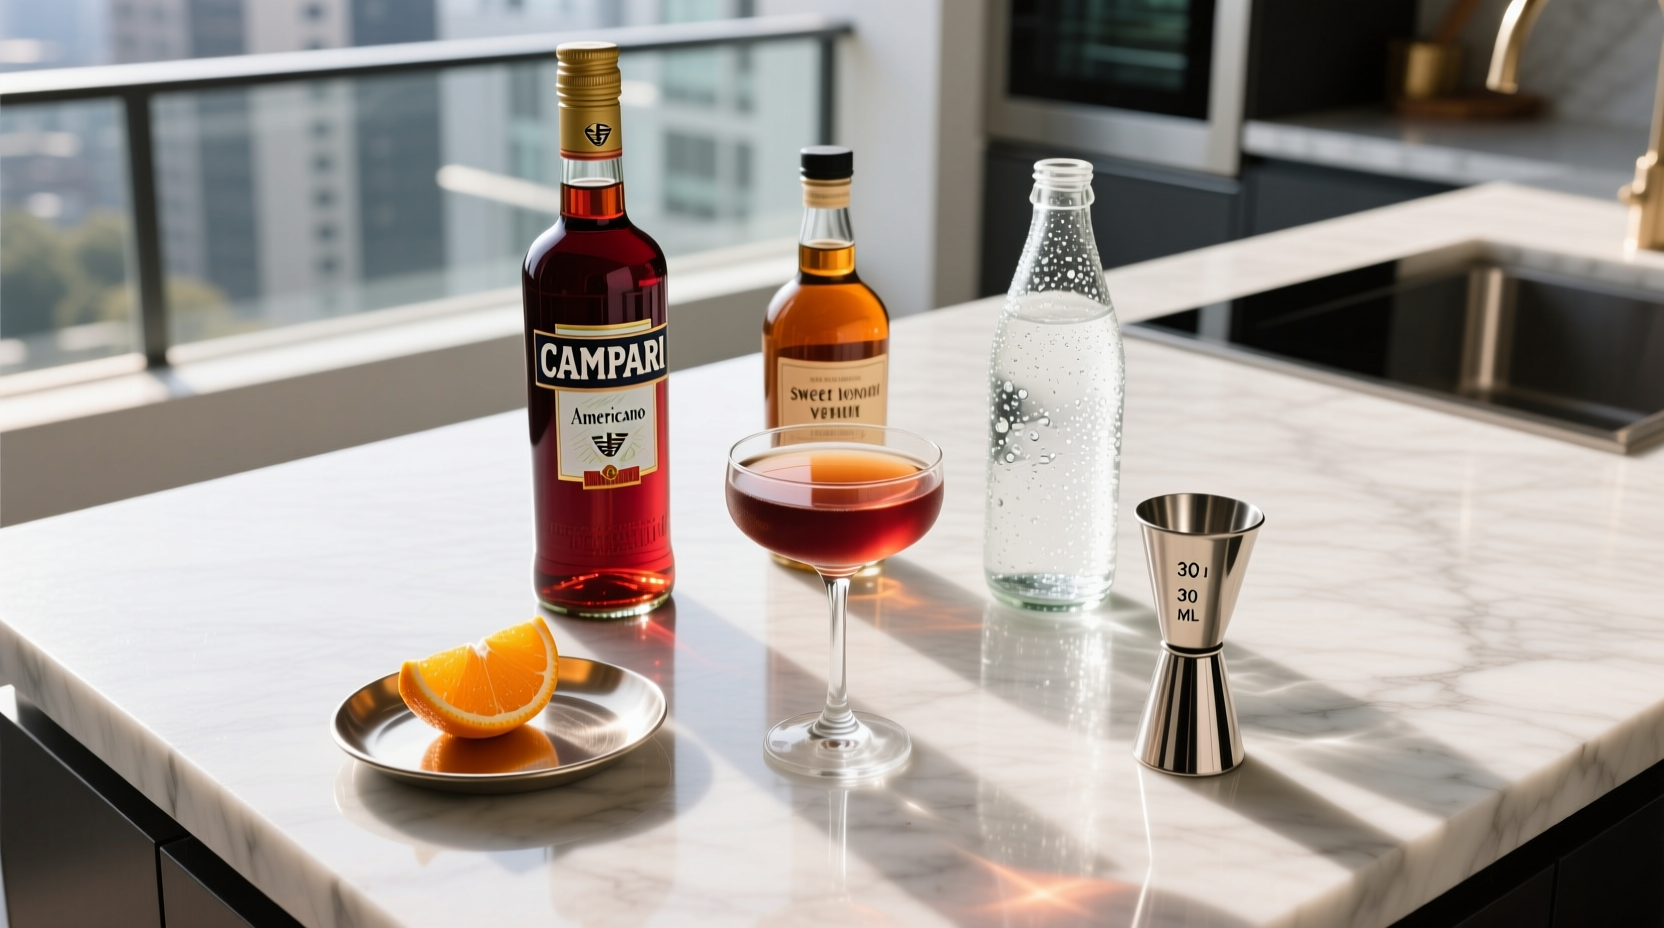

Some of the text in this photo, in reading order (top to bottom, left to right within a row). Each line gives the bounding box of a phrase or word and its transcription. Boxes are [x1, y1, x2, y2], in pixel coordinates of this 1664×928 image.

[540, 335, 665, 380] CAMPARI
[571, 406, 646, 425] Americano
[1177, 561, 1200, 578] 30
[1177, 588, 1198, 603] 30
[1177, 608, 1200, 622] ML
